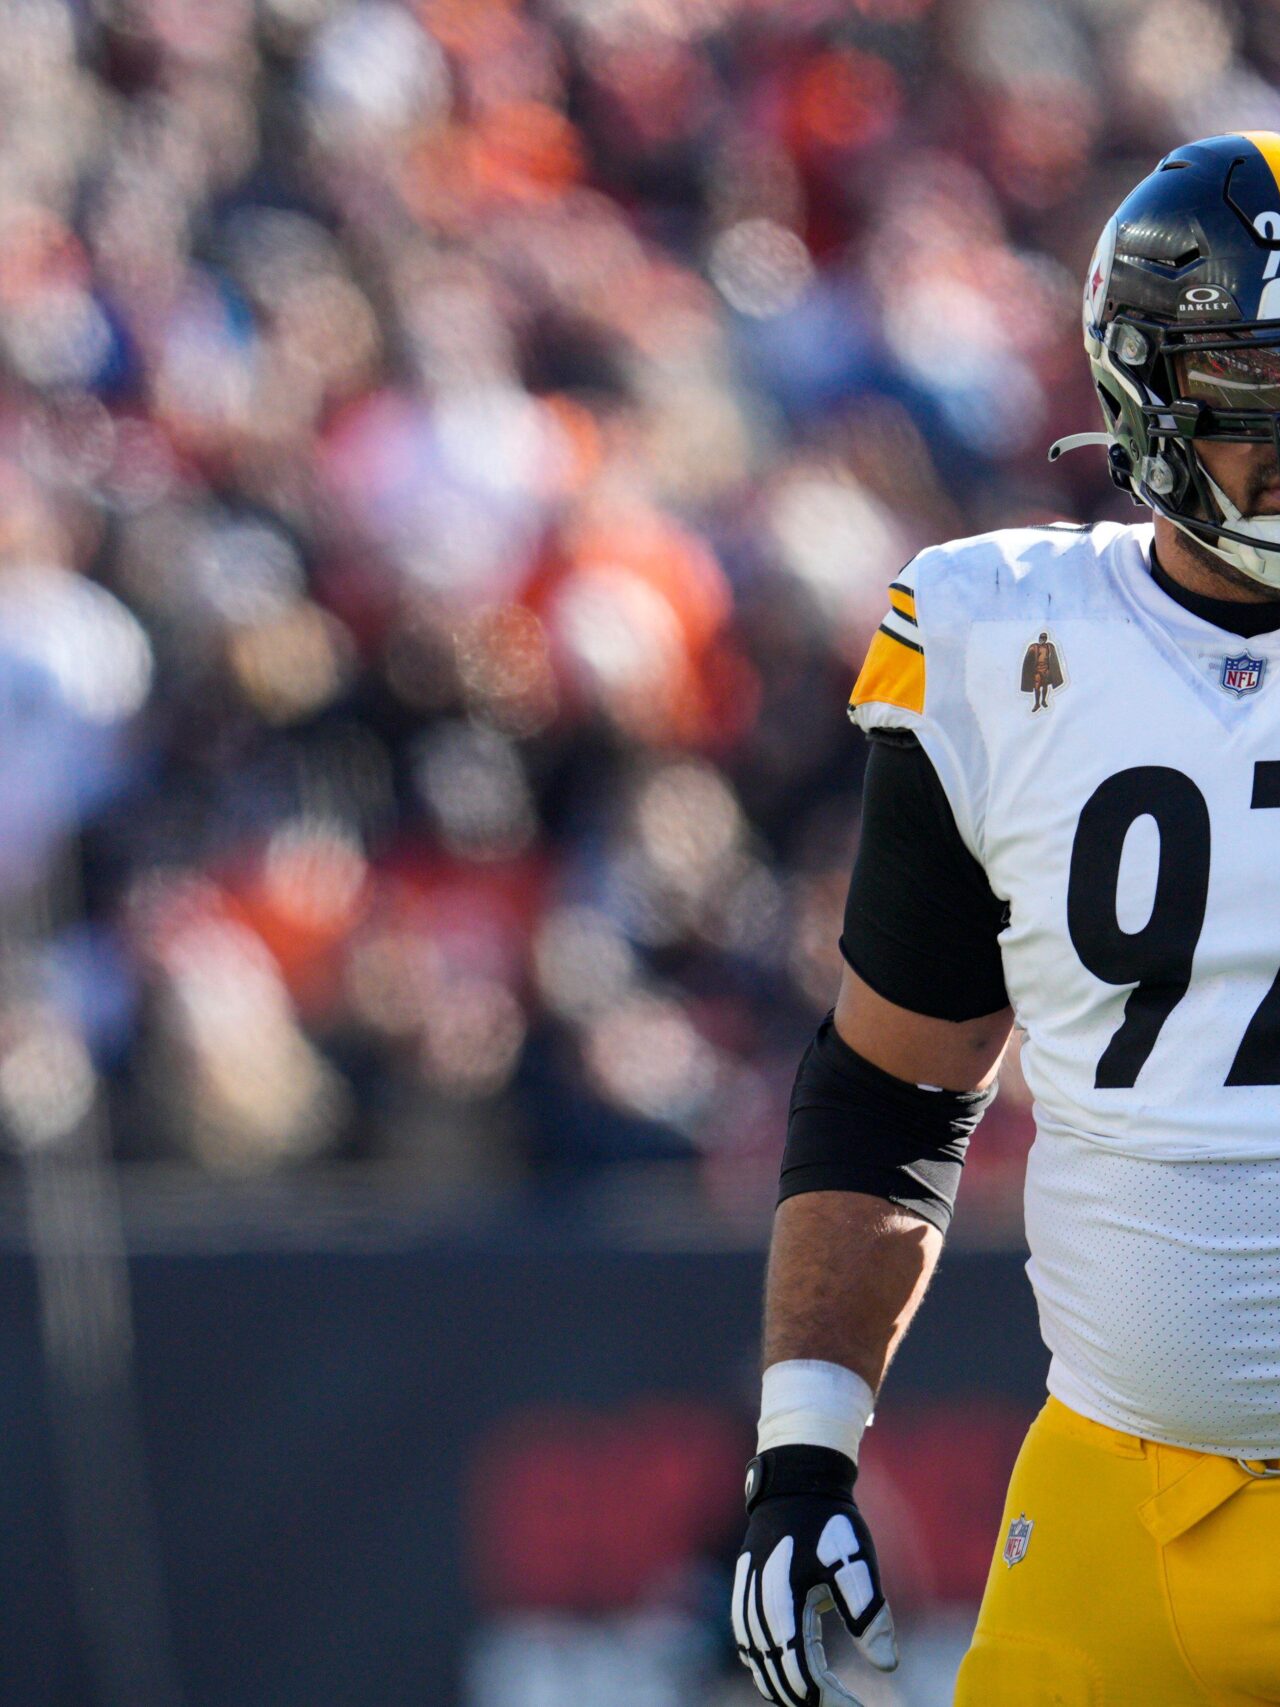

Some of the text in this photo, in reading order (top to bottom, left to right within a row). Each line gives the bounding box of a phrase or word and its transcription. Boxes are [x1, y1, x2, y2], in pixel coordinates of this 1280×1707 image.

[1179, 302, 1229, 311] OAKLEY
[1226, 670, 1256, 688] NFL
[1005, 1538, 1022, 1557] NFL
